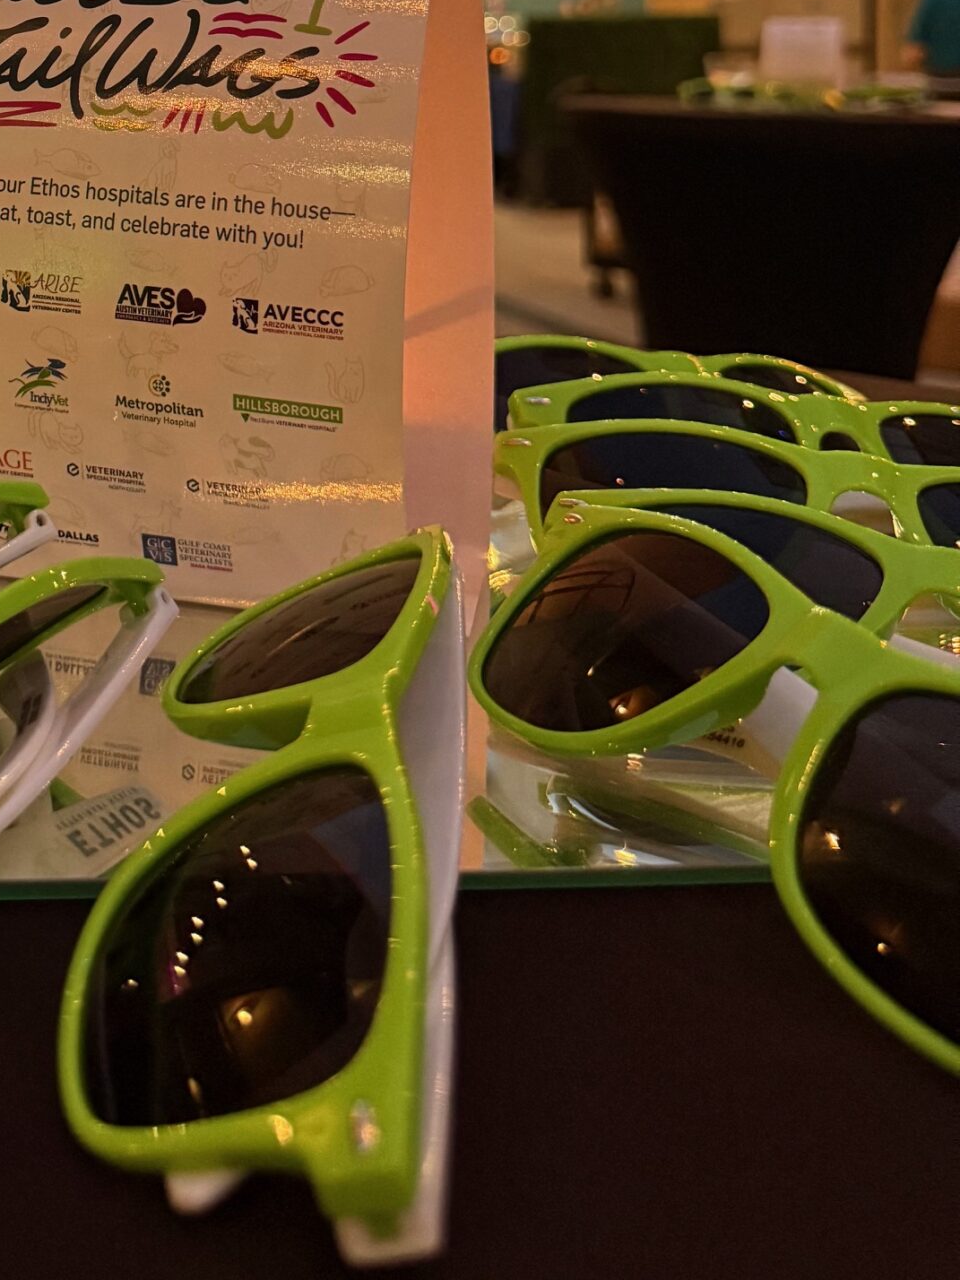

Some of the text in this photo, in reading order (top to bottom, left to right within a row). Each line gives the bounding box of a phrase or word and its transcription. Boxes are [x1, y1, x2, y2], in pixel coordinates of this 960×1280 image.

[31, 176, 81, 199] Ethos
[86, 181, 170, 208] hospitals
[175, 194, 206, 209] are
[211, 192, 228, 212] in
[233, 194, 265, 215] the
[27, 206, 76, 230] toast,
[81, 213, 115, 231] and
[120, 215, 210, 240] celebrate
[216, 223, 257, 244] with
[262, 230, 304, 250] you!
[30, 273, 83, 294] ARISE
[117, 284, 176, 310] AVES
[116, 304, 173, 318] AUSTIN VETERINARY
[263, 304, 344, 328] AVECCC
[263, 320, 344, 336] ARIZONA VETERINARY
[29, 391, 69, 407] IndyVet
[115, 394, 204, 418] Metropolitan
[235, 397, 340, 421] HILLSBOROUGH
[121, 411, 196, 429] Veterinary Hospital
[275, 419, 307, 429] VETERINARY
[85, 464, 145, 480] VETERINARY
[86, 473, 145, 486] SPECIALTY HOSPITAL
[206, 480, 267, 496] VETERINARY
[58, 529, 100, 543] DALLAS
[177, 538, 232, 552] GULF COAST
[178, 546, 232, 559] VETERINARY
[179, 554, 233, 567] SPECIALISTS
